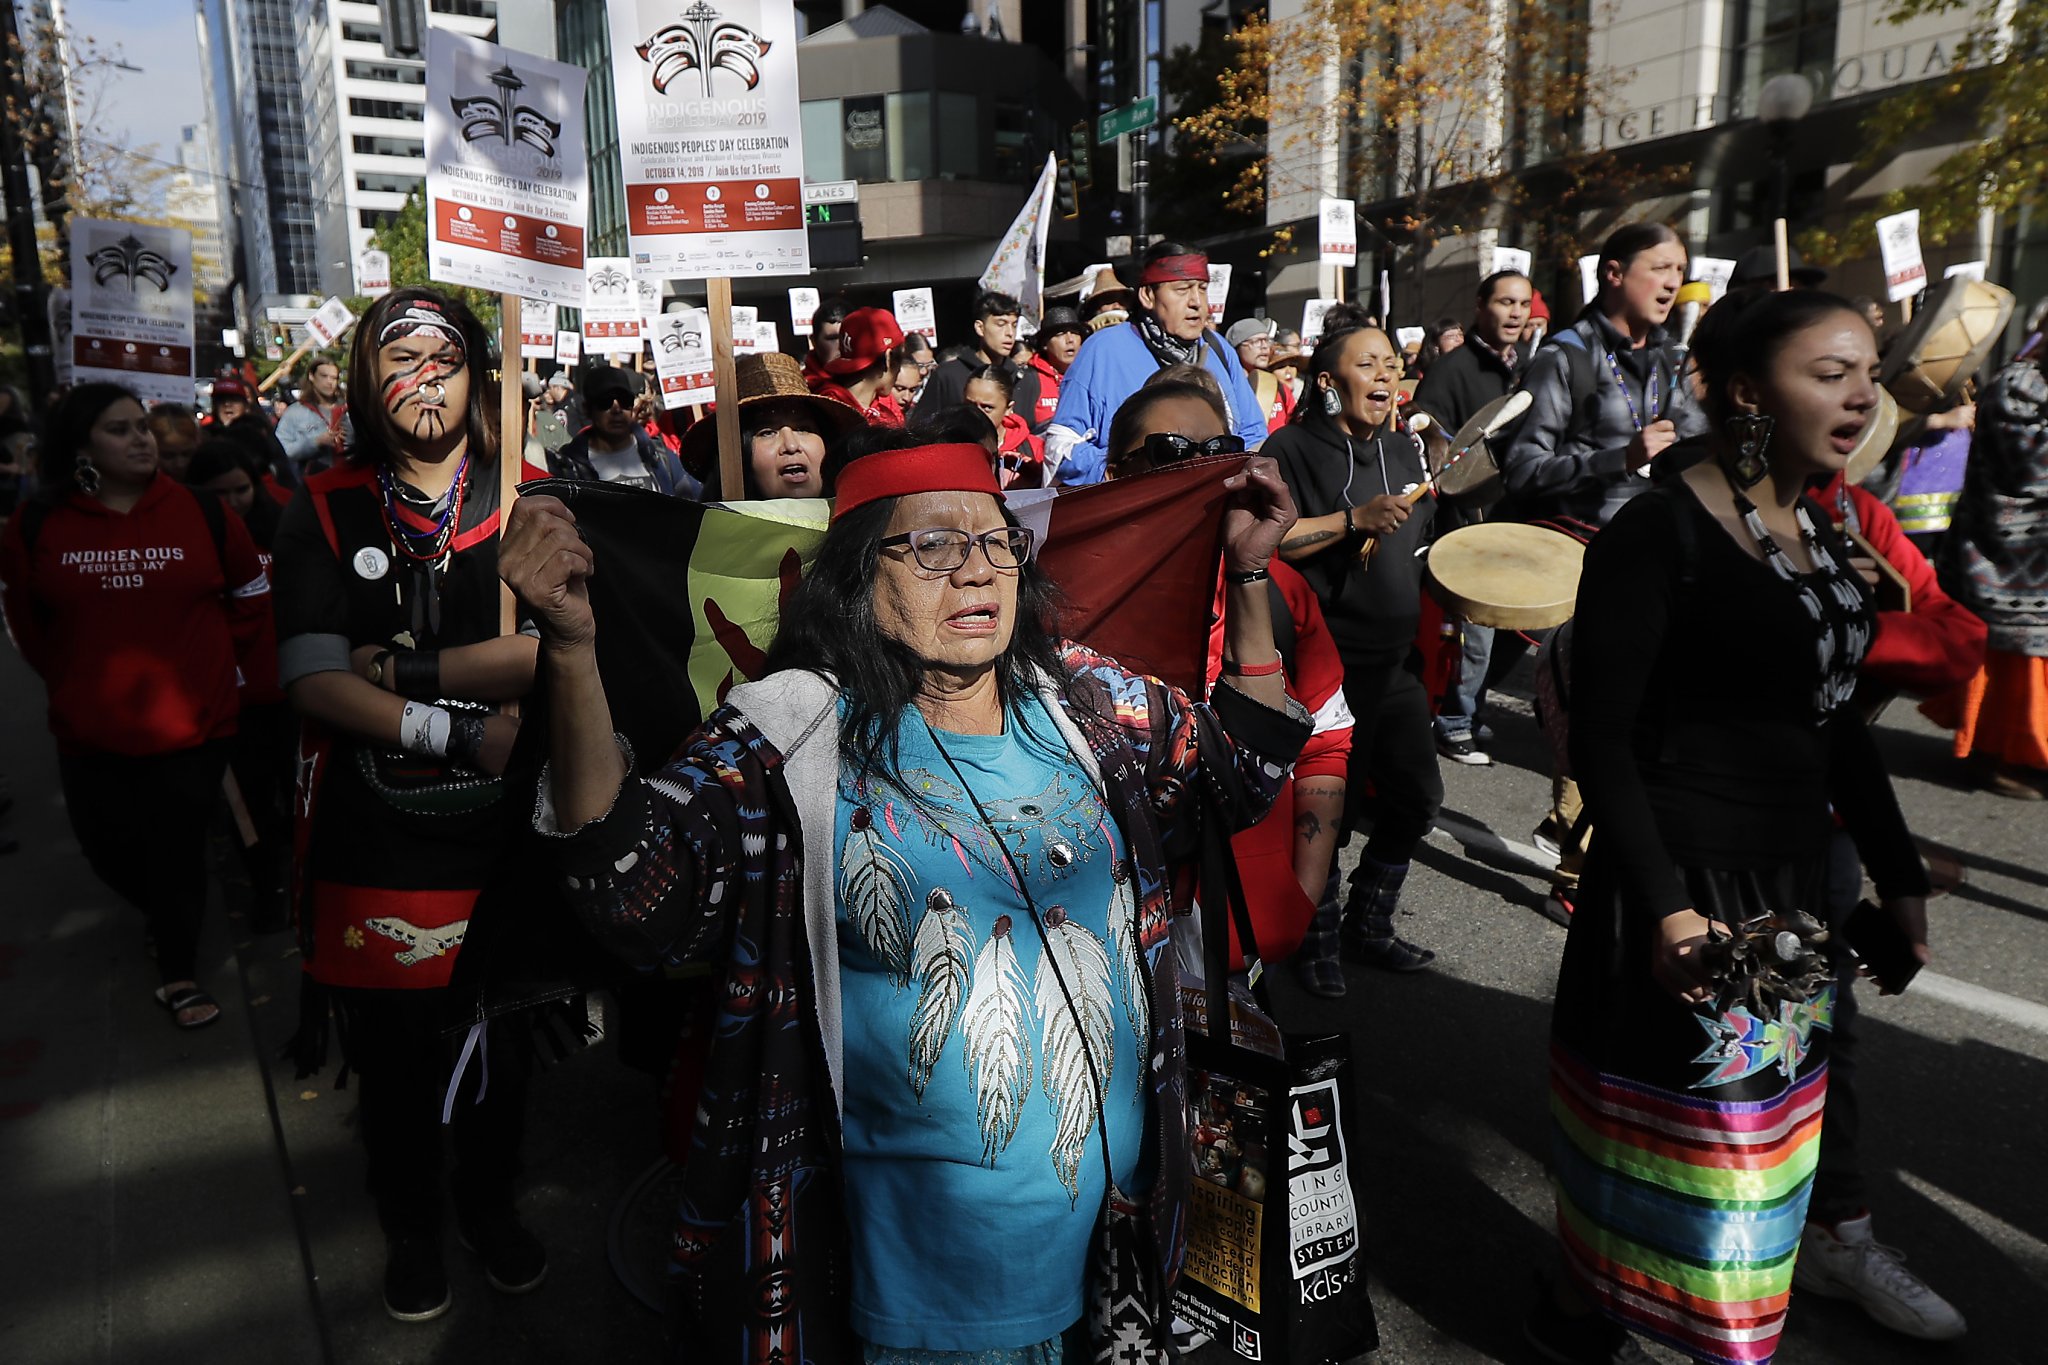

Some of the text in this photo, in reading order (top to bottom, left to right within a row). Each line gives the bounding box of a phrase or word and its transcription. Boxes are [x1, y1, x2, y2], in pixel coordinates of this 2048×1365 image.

[646, 98, 767, 117] INDIGENOUS
[737, 112, 767, 126] 2019
[631, 141, 679, 155] INDIGENOUS
[719, 139, 735, 152] DAY
[737, 136, 789, 151] CELEBRATION
[536, 166, 562, 180] 2019
[645, 167, 675, 179] OCTOBER
[687, 166, 704, 177] 2019
[716, 165, 729, 176] Join
[730, 165, 739, 176] Us
[740, 164, 751, 175] for
[751, 164, 757, 174] 3
[758, 163, 781, 174] Events
[440, 164, 483, 182] INDIGENOUS
[518, 180, 532, 192] DAY
[532, 183, 577, 202] CELEBRATION
[807, 187, 845, 199] LANES
[550, 207, 568, 220] Events
[805, 205, 831, 223] EN
[61, 547, 184, 565] INDIGENOUS
[1191, 1183, 1256, 1226] nspiring
[1290, 1190, 1346, 1221] COUNTY
[1294, 1212, 1350, 1243] LIBRARY
[1219, 1227, 1255, 1250] county
[1297, 1232, 1354, 1264] SYSTEM
[1187, 1250, 1255, 1294] nteraction
[1202, 1271, 1254, 1305] information
[1181, 1304, 1200, 1320] when
[1190, 1294, 1211, 1316] library
